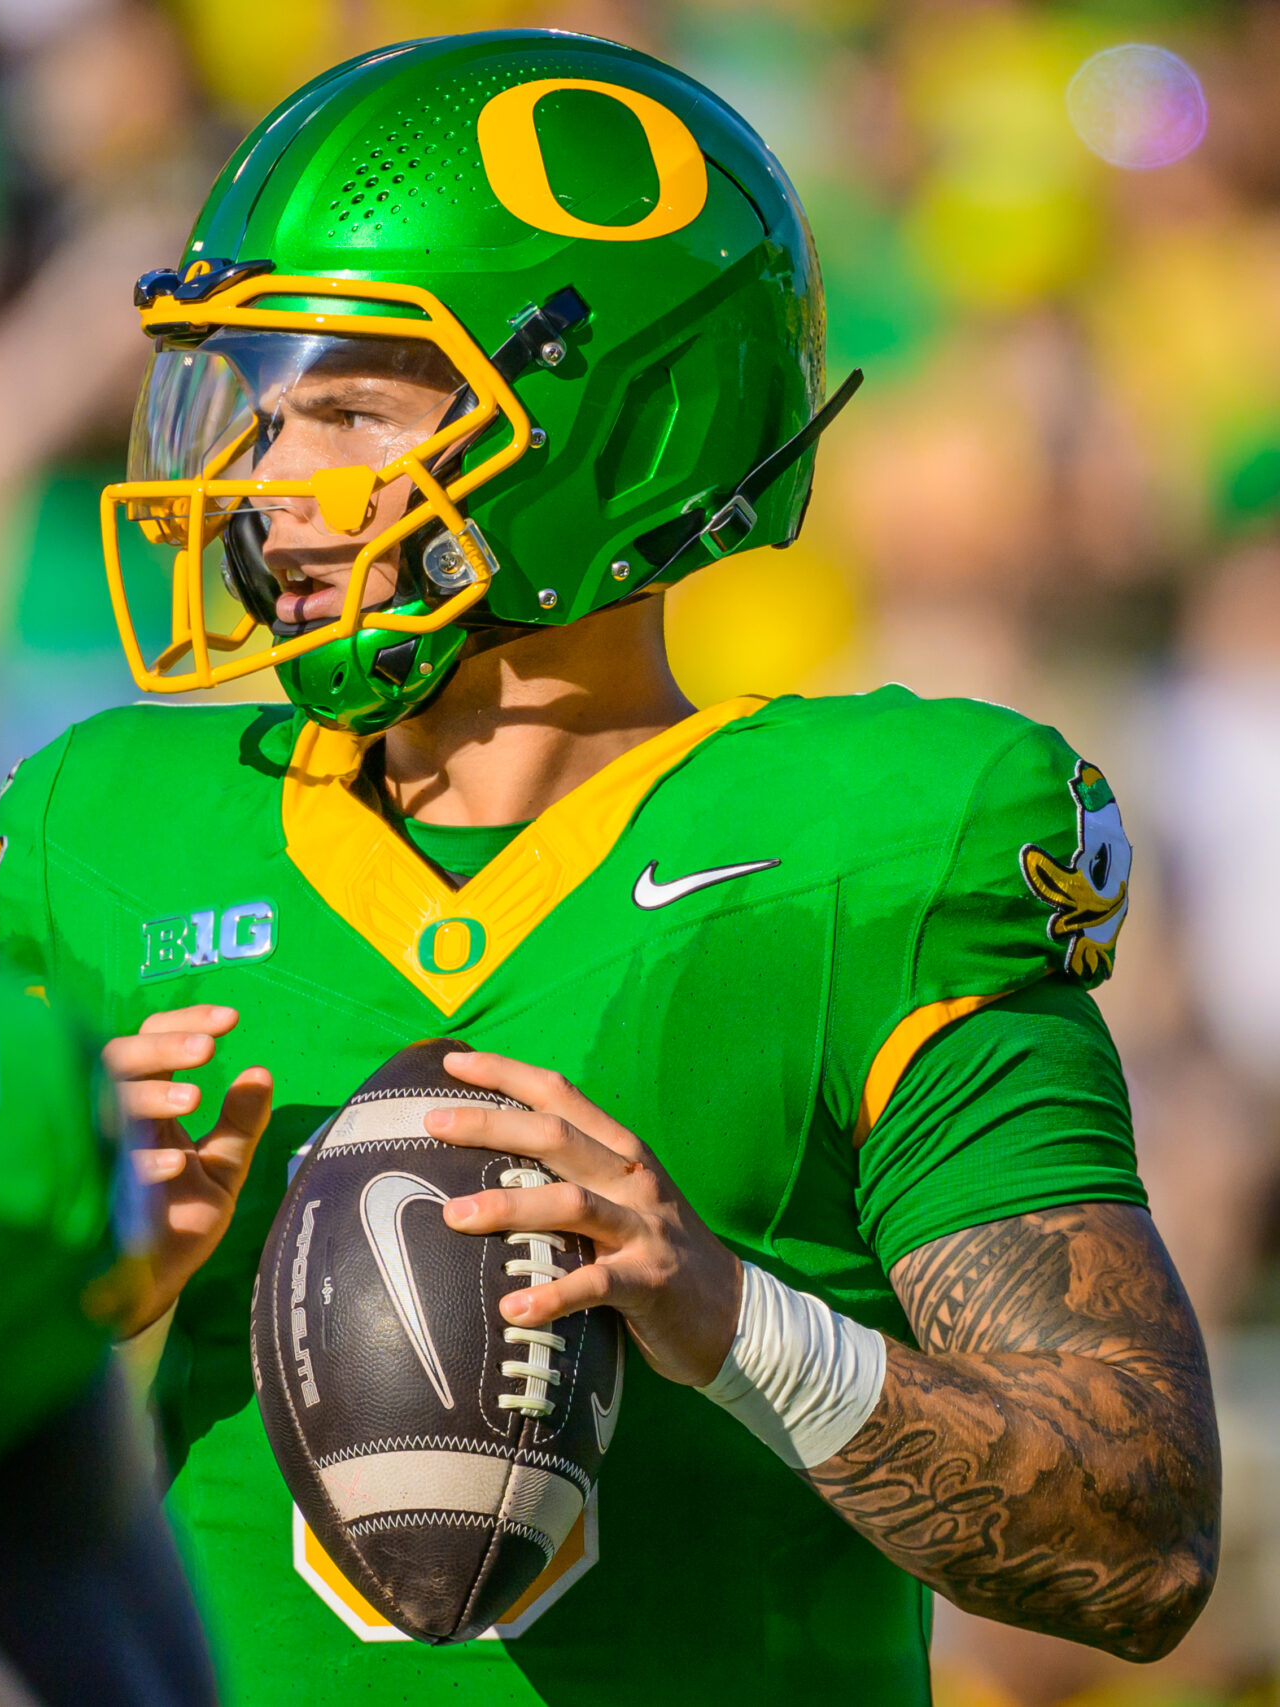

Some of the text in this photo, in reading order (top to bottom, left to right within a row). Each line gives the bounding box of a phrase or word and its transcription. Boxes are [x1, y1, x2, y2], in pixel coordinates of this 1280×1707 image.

[477, 78, 709, 242] O
[418, 917, 486, 974] O
[291, 1199, 321, 1409] VAPOR ELITE
